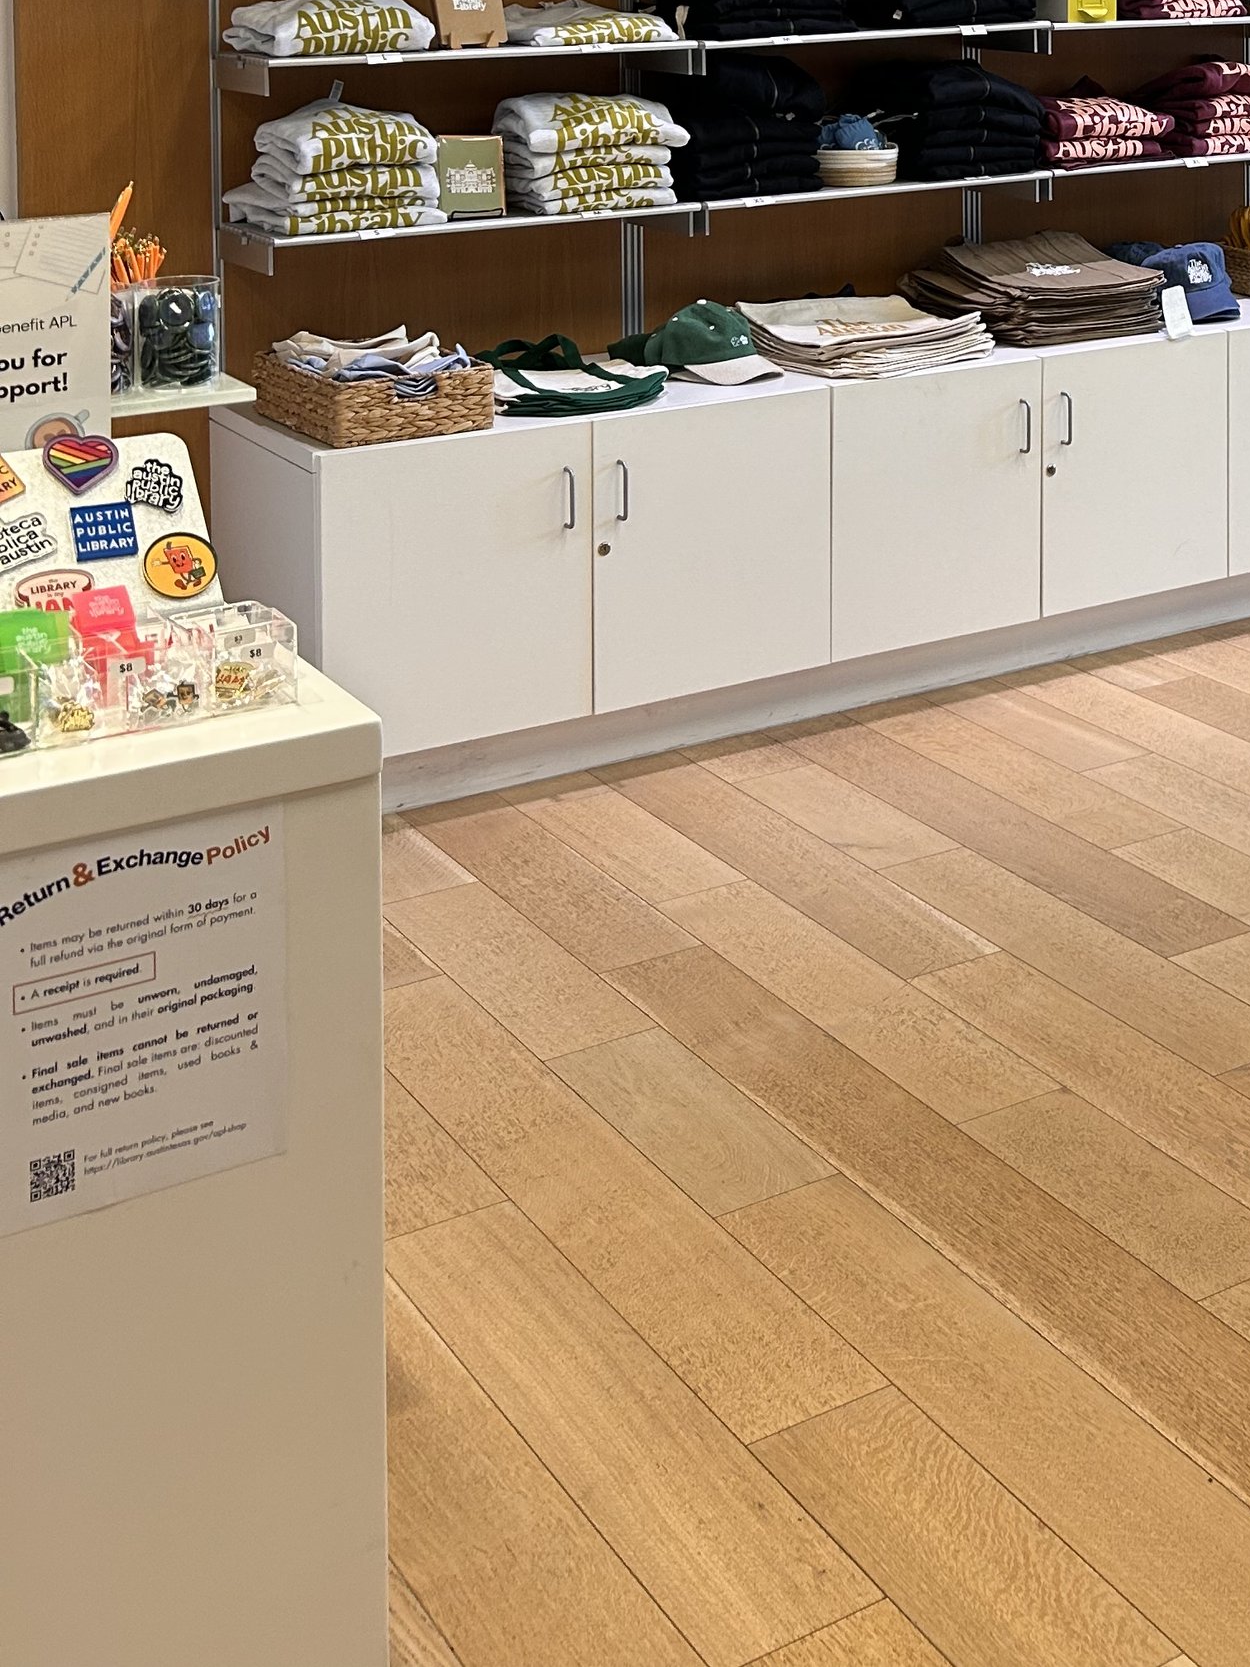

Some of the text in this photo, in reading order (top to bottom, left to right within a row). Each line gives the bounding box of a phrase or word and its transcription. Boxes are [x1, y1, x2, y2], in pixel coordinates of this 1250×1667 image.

[453, 0, 486, 11] Library
[293, 5, 413, 39] Austin
[310, 117, 428, 142] Austin
[1056, 138, 1144, 160] Austin
[299, 165, 423, 196] Austin
[553, 165, 663, 190] Austin
[0, 314, 77, 334] enefit APL
[32, 347, 68, 368] for
[133, 469, 180, 487] austin
[145, 461, 170, 475] the
[127, 483, 180, 509] library
[74, 508, 130, 524] AUSTIN
[77, 522, 133, 538] PUBLIC
[1, 539, 52, 566] austin
[78, 536, 135, 553] LIBRARY
[30, 580, 78, 595] LIBRARY
[249, 648, 262, 659] $8
[119, 663, 133, 673] $8
[0, 825, 271, 927] Return & Exchange Policy
[30, 891, 257, 952] Items may be returned within 30 days for a
[30, 906, 255, 969] full refund via the original form of payment.
[31, 990, 39, 1000] A
[43, 980, 80, 997] receipt
[83, 975, 91, 987] is
[31, 964, 258, 1032] Items must be unworn, undamaged,
[31, 1024, 90, 1047] unwashed,
[94, 1016, 115, 1032] and
[118, 1014, 128, 1025] in
[131, 1005, 155, 1022] their
[157, 993, 197, 1014] original
[32, 1010, 258, 1079] Final sale items cannot be returned or
[32, 1069, 94, 1095] exchanged.
[98, 1060, 123, 1076] Final
[127, 1054, 148, 1070] sale
[151, 1049, 177, 1063] items
[204, 1023, 258, 1048] discounted
[32, 1039, 258, 1111] items, consigned items, used books &
[32, 1109, 69, 1127] media,
[74, 1099, 95, 1116] and
[98, 1095, 120, 1108] new
[114, 1142, 139, 1155] return
